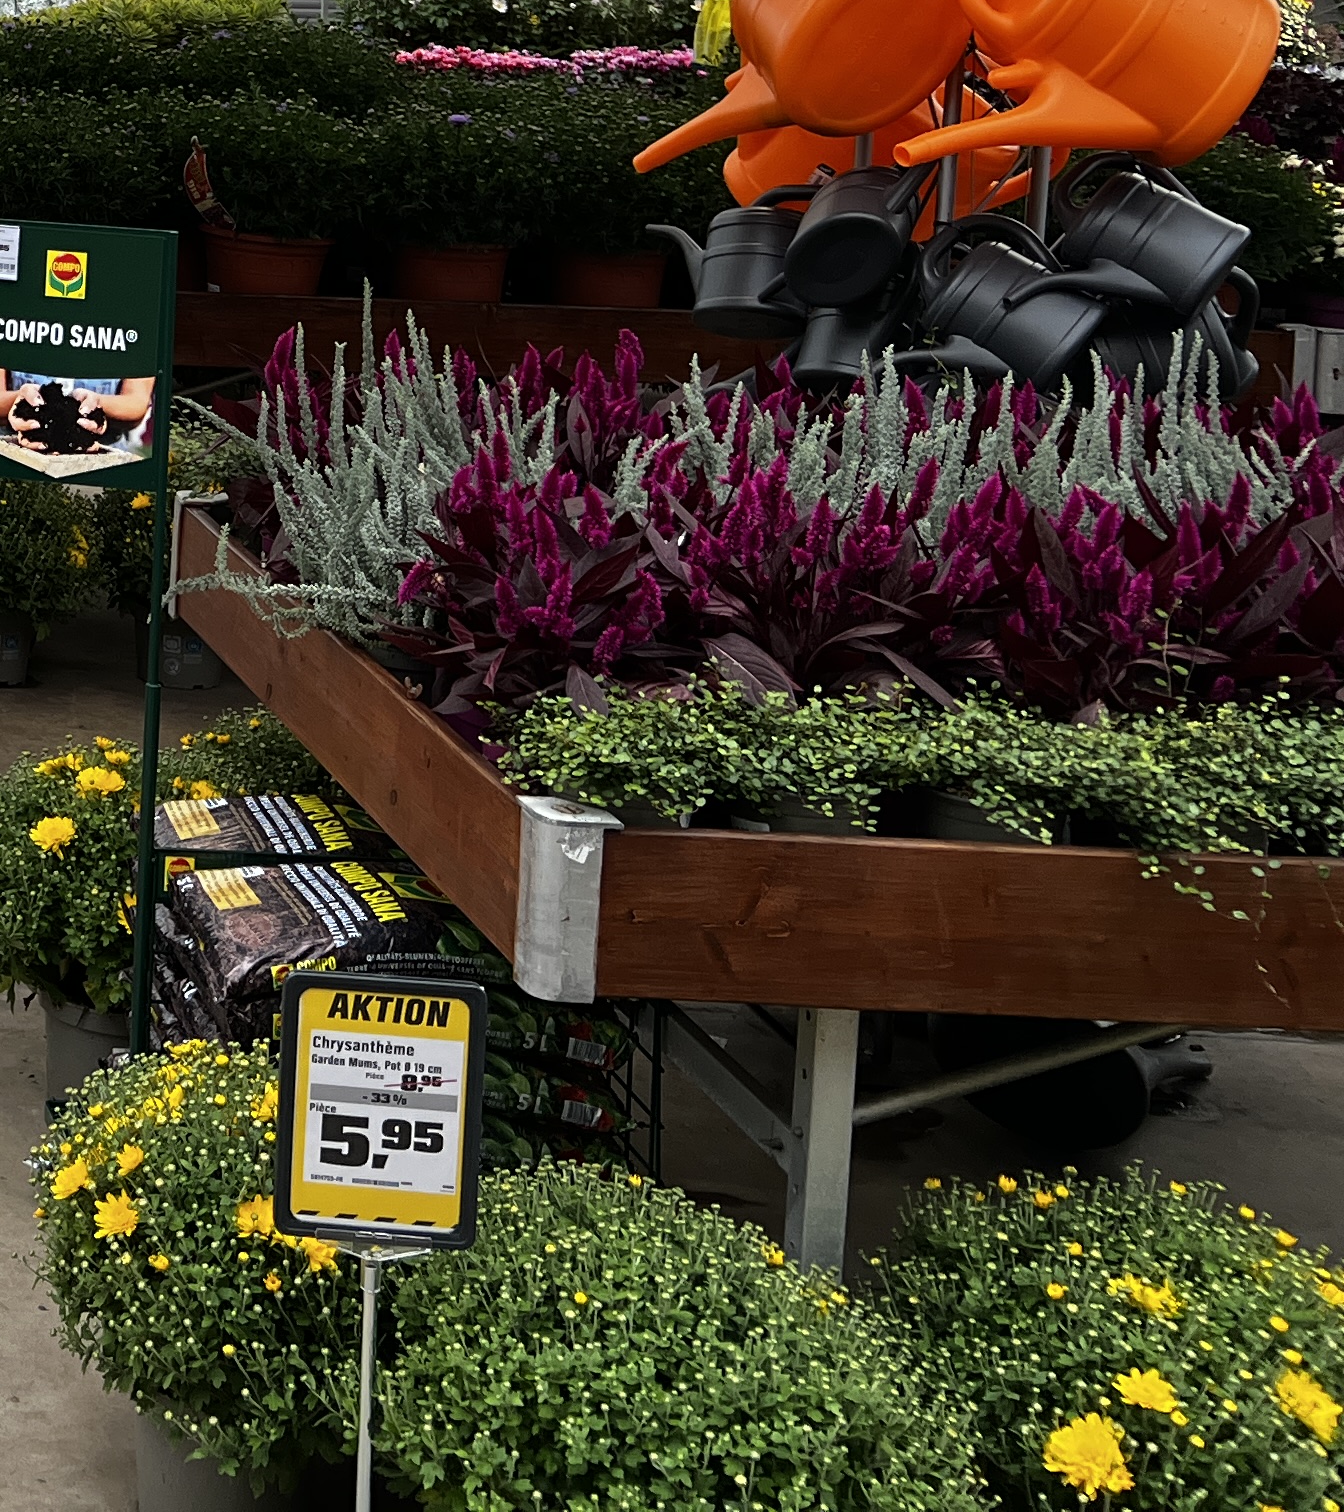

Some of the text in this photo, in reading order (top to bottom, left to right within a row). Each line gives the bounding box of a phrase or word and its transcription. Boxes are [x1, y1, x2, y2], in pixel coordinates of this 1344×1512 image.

[51, 261, 82, 274] COMPO
[69, 324, 138, 352] SANA®
[330, 861, 383, 892] COMPO
[327, 992, 451, 1028] AKTION
[312, 1035, 415, 1057] Chrysanthème
[311, 1053, 346, 1067] Garden
[348, 1056, 382, 1071] Mums,
[384, 1060, 402, 1072] Pot
[414, 1062, 426, 1073] 19
[427, 1065, 443, 1075] cm
[309, 1102, 338, 1114] Pièce
[319, 1113, 444, 1169] 5,95
